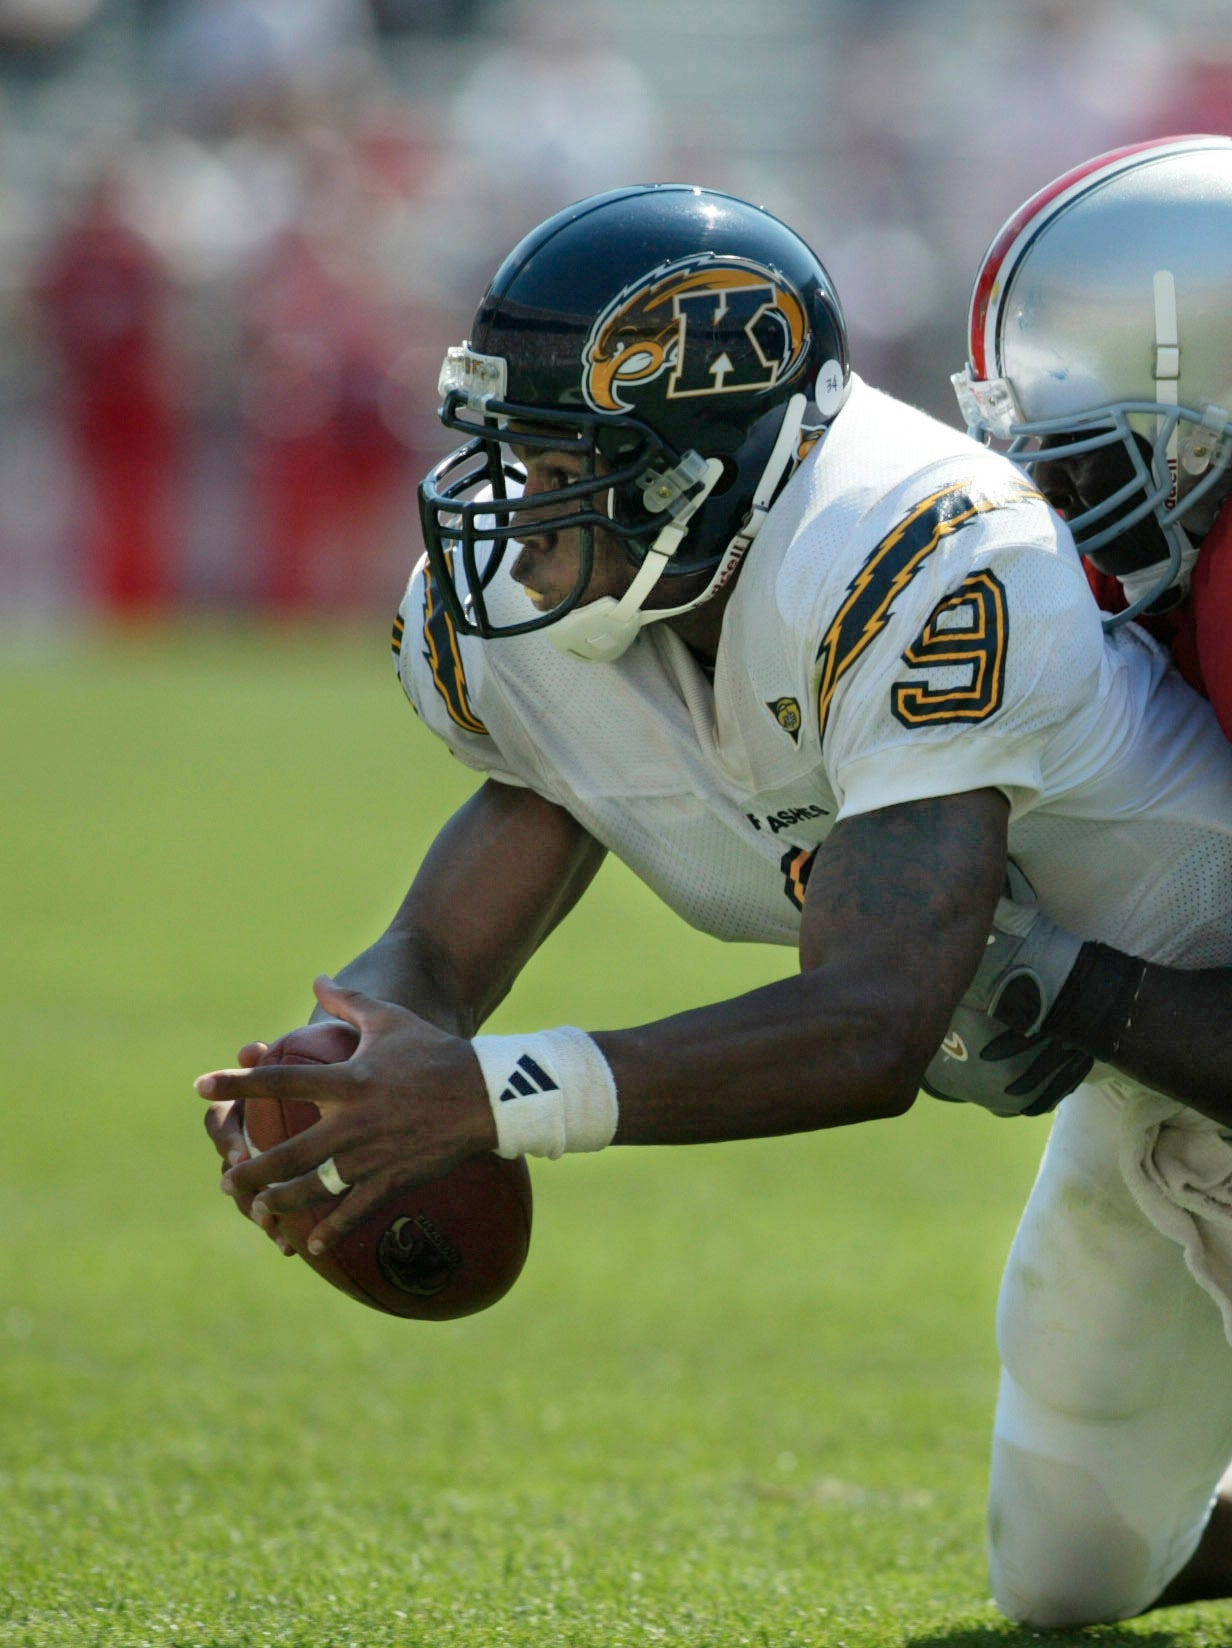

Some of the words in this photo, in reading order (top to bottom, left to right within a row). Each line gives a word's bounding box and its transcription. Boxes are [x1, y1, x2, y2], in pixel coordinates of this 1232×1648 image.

[666, 282, 777, 399] K
[891, 567, 1010, 730] 9
[746, 804, 830, 834] FASHES
